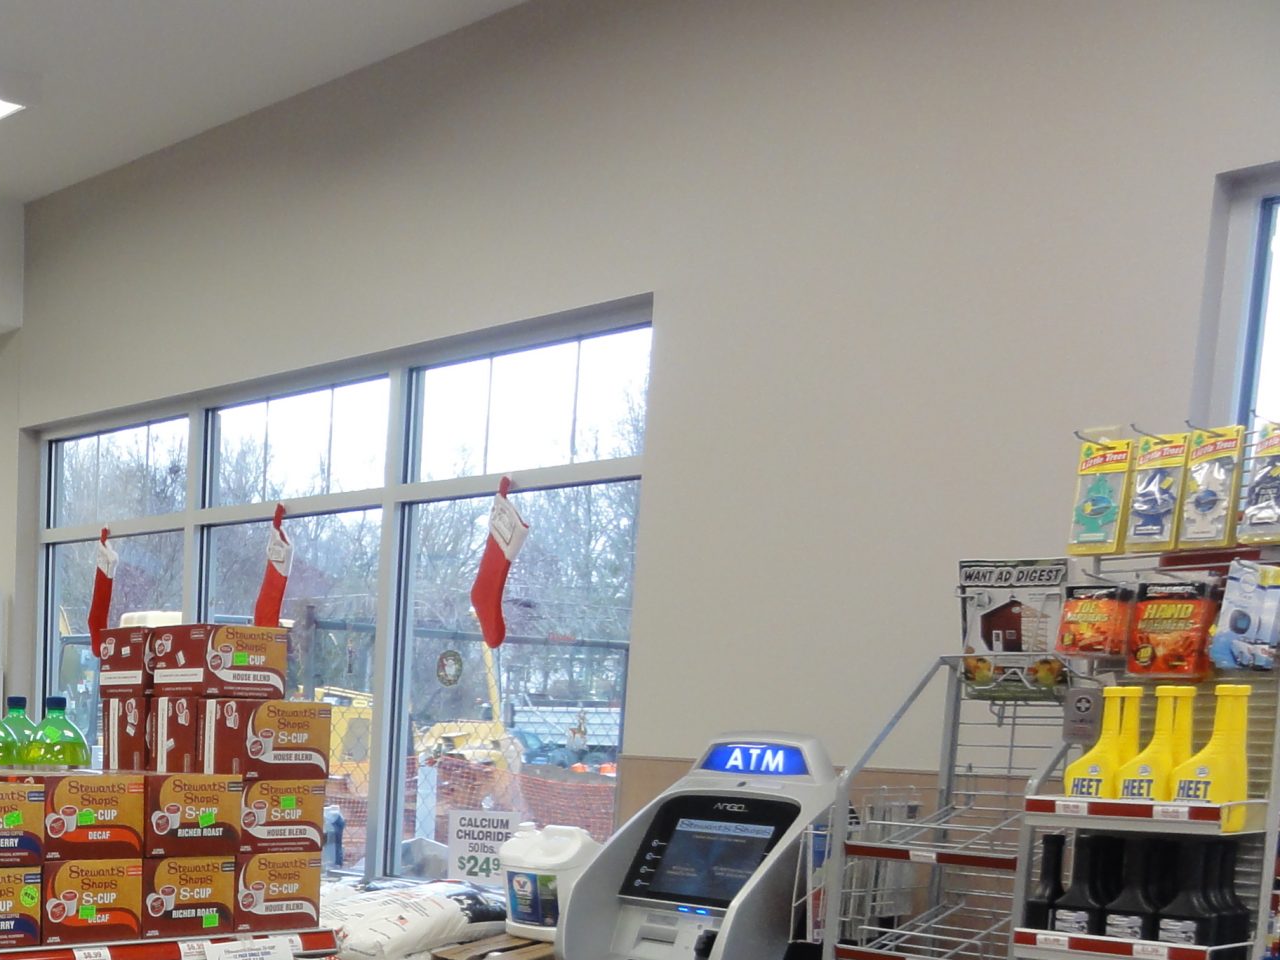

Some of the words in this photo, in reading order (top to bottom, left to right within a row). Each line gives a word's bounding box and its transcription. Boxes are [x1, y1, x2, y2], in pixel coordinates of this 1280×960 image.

[1139, 450, 1162, 464] Little
[1192, 444, 1214, 457] Little
[1081, 456, 1104, 469] Little
[964, 569, 994, 583] WANT
[996, 569, 1013, 583] AD
[1016, 568, 1062, 583] DIGEST
[1143, 603, 1195, 619] HAND
[1138, 619, 1194, 632] WARMERS
[277, 731, 309, 744] S-CUP
[725, 748, 784, 772] ATM
[1071, 778, 1103, 796] HEET
[1121, 778, 1154, 797] HEET
[1176, 780, 1211, 799] HEET
[271, 808, 302, 821] S-CUP
[458, 816, 510, 830] CALCIUM
[88, 830, 111, 841] DECAF
[177, 828, 202, 838] RICHER
[202, 827, 224, 837] ROAST
[456, 829, 512, 842] CHLORIDE
[179, 887, 212, 901] S-CUP
[269, 882, 299, 895] S-CUP
[82, 891, 117, 906] S-CUP
[172, 909, 196, 919] RICHER
